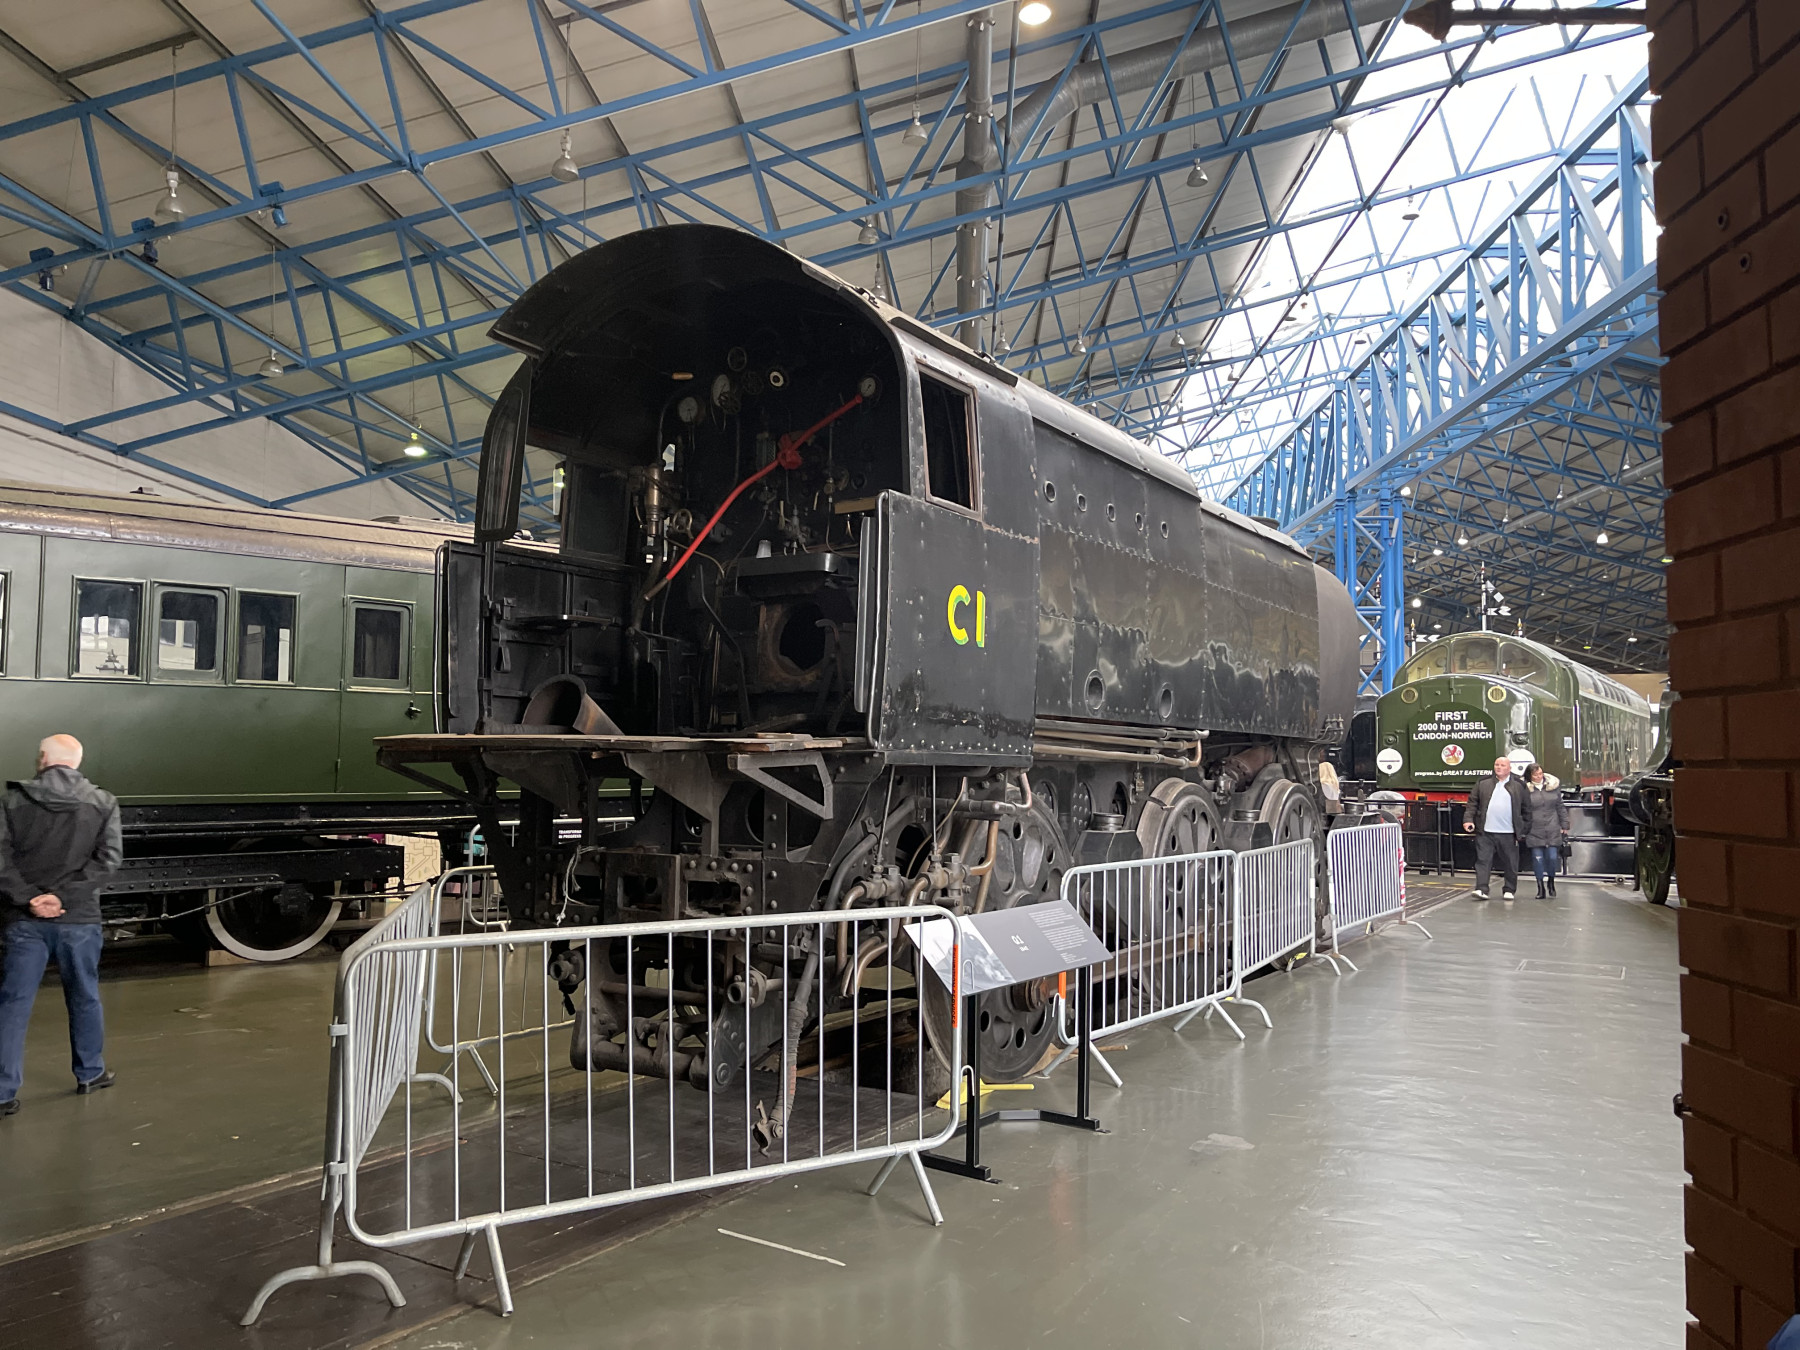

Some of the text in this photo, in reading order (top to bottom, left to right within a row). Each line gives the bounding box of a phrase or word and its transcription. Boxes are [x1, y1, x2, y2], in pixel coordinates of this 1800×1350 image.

[1434, 711, 1469, 721] FIRST
[1417, 722, 1487, 732] 2000 hp DIESEL
[1412, 731, 1493, 741] LONDON-NORWICH
